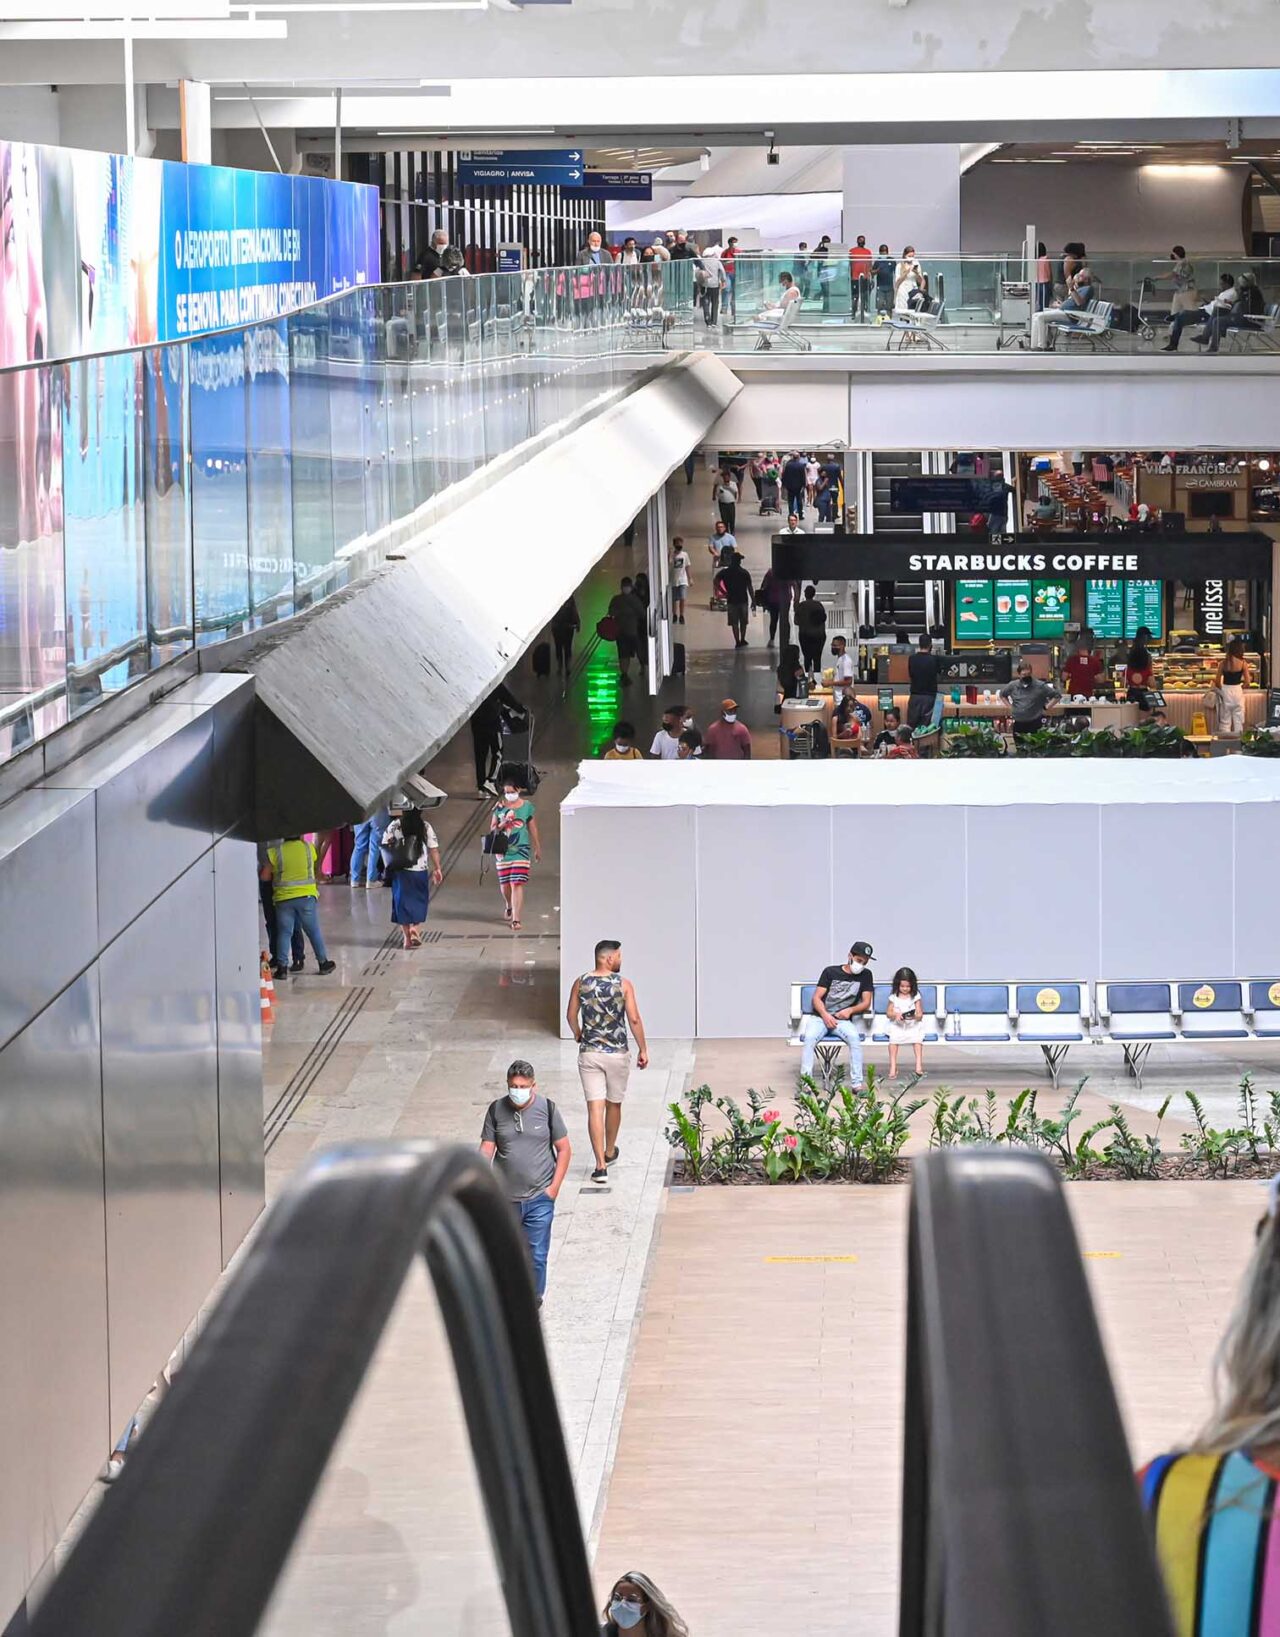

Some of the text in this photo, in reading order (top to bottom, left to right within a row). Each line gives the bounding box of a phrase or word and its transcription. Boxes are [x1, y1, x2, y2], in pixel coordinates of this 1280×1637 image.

[175, 229, 182, 269] O
[184, 230, 229, 268] AEROPORTO
[283, 228, 293, 262] DE
[176, 293, 188, 333] SE
[1145, 464, 1240, 475] VILA FRANCISCA
[1199, 480, 1238, 488] CAMBRAIA
[909, 554, 1138, 571] STARBUCKS COFFEE
[1204, 579, 1224, 635] melissa
